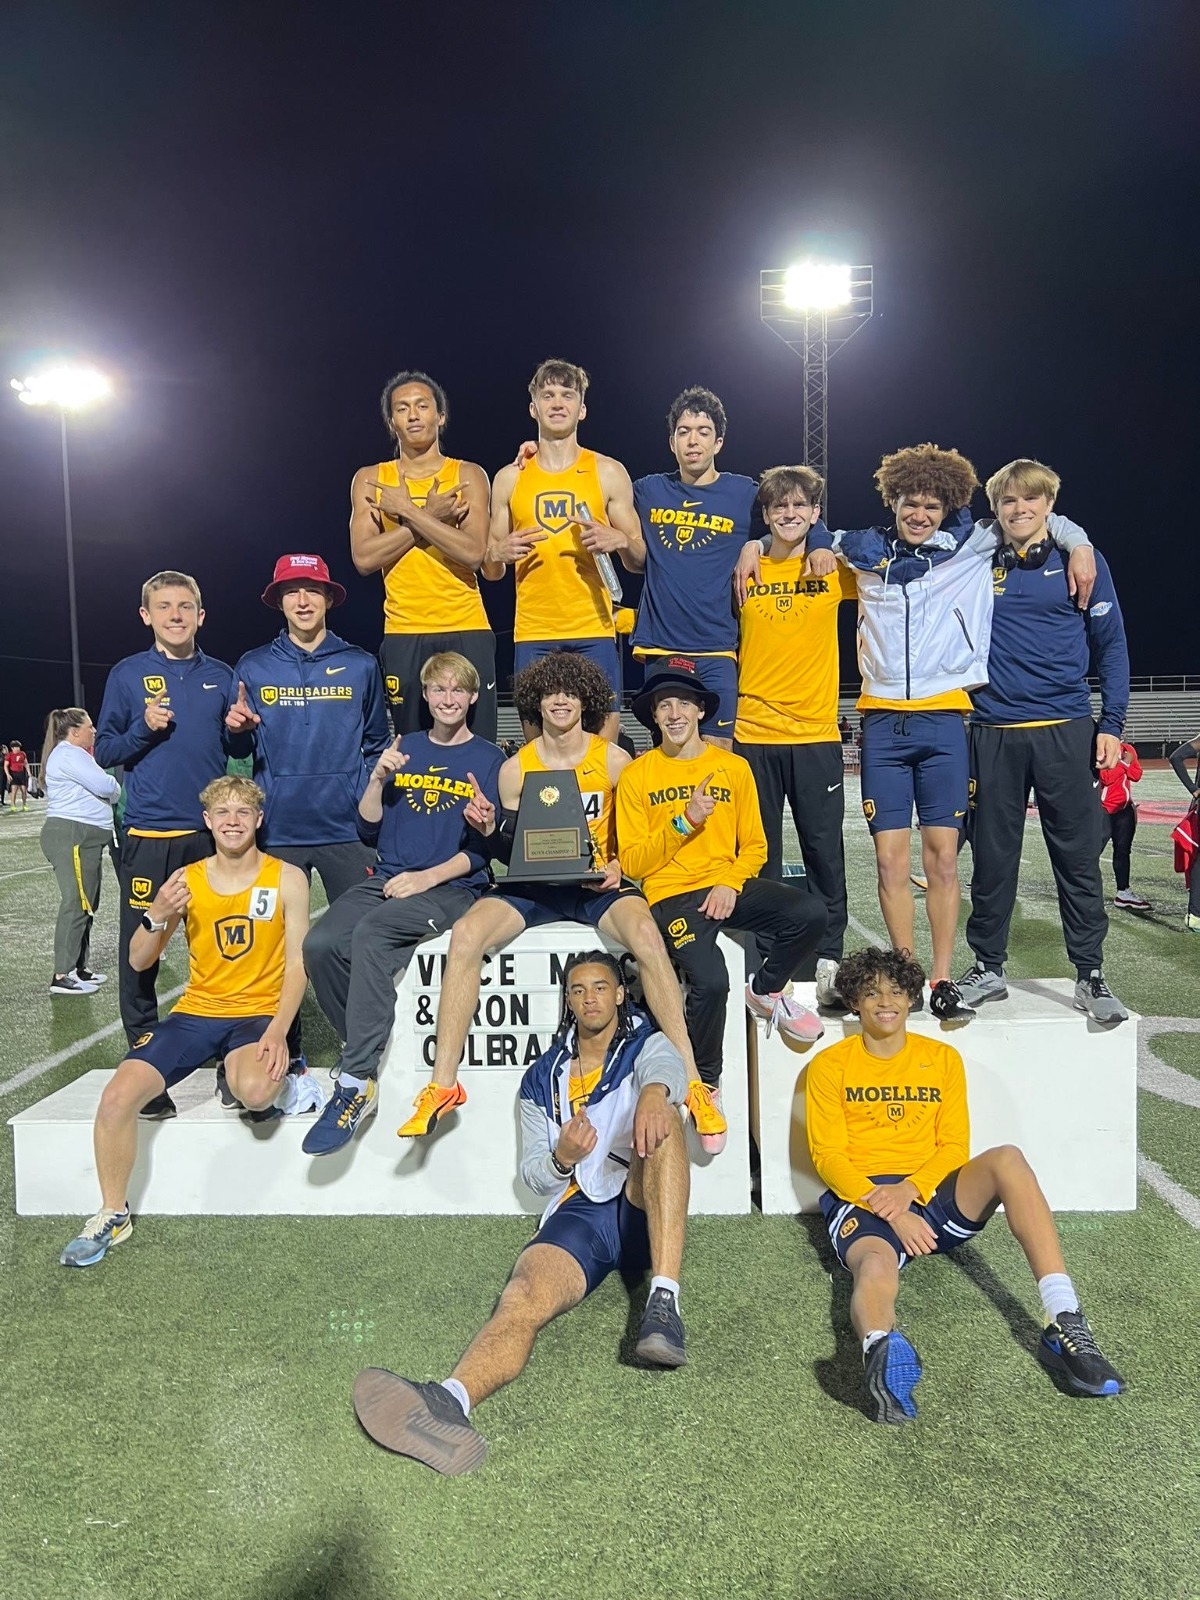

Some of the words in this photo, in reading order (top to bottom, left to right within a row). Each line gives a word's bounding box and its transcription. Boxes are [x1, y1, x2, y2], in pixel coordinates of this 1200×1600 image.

[543, 499, 567, 518] M
[649, 508, 734, 533] MOELLER
[746, 580, 829, 598] MOELLER
[279, 686, 353, 697] CRUSADERS
[584, 793, 600, 819] 4
[648, 785, 731, 806] MOELER
[129, 899, 152, 908] Moelle
[255, 889, 269, 916] 5
[224, 925, 246, 945] M
[417, 953, 515, 987] VICE
[415, 994, 435, 1026] &
[423, 1033, 558, 1067] CLERA
[845, 1086, 942, 1102] MOELLER
